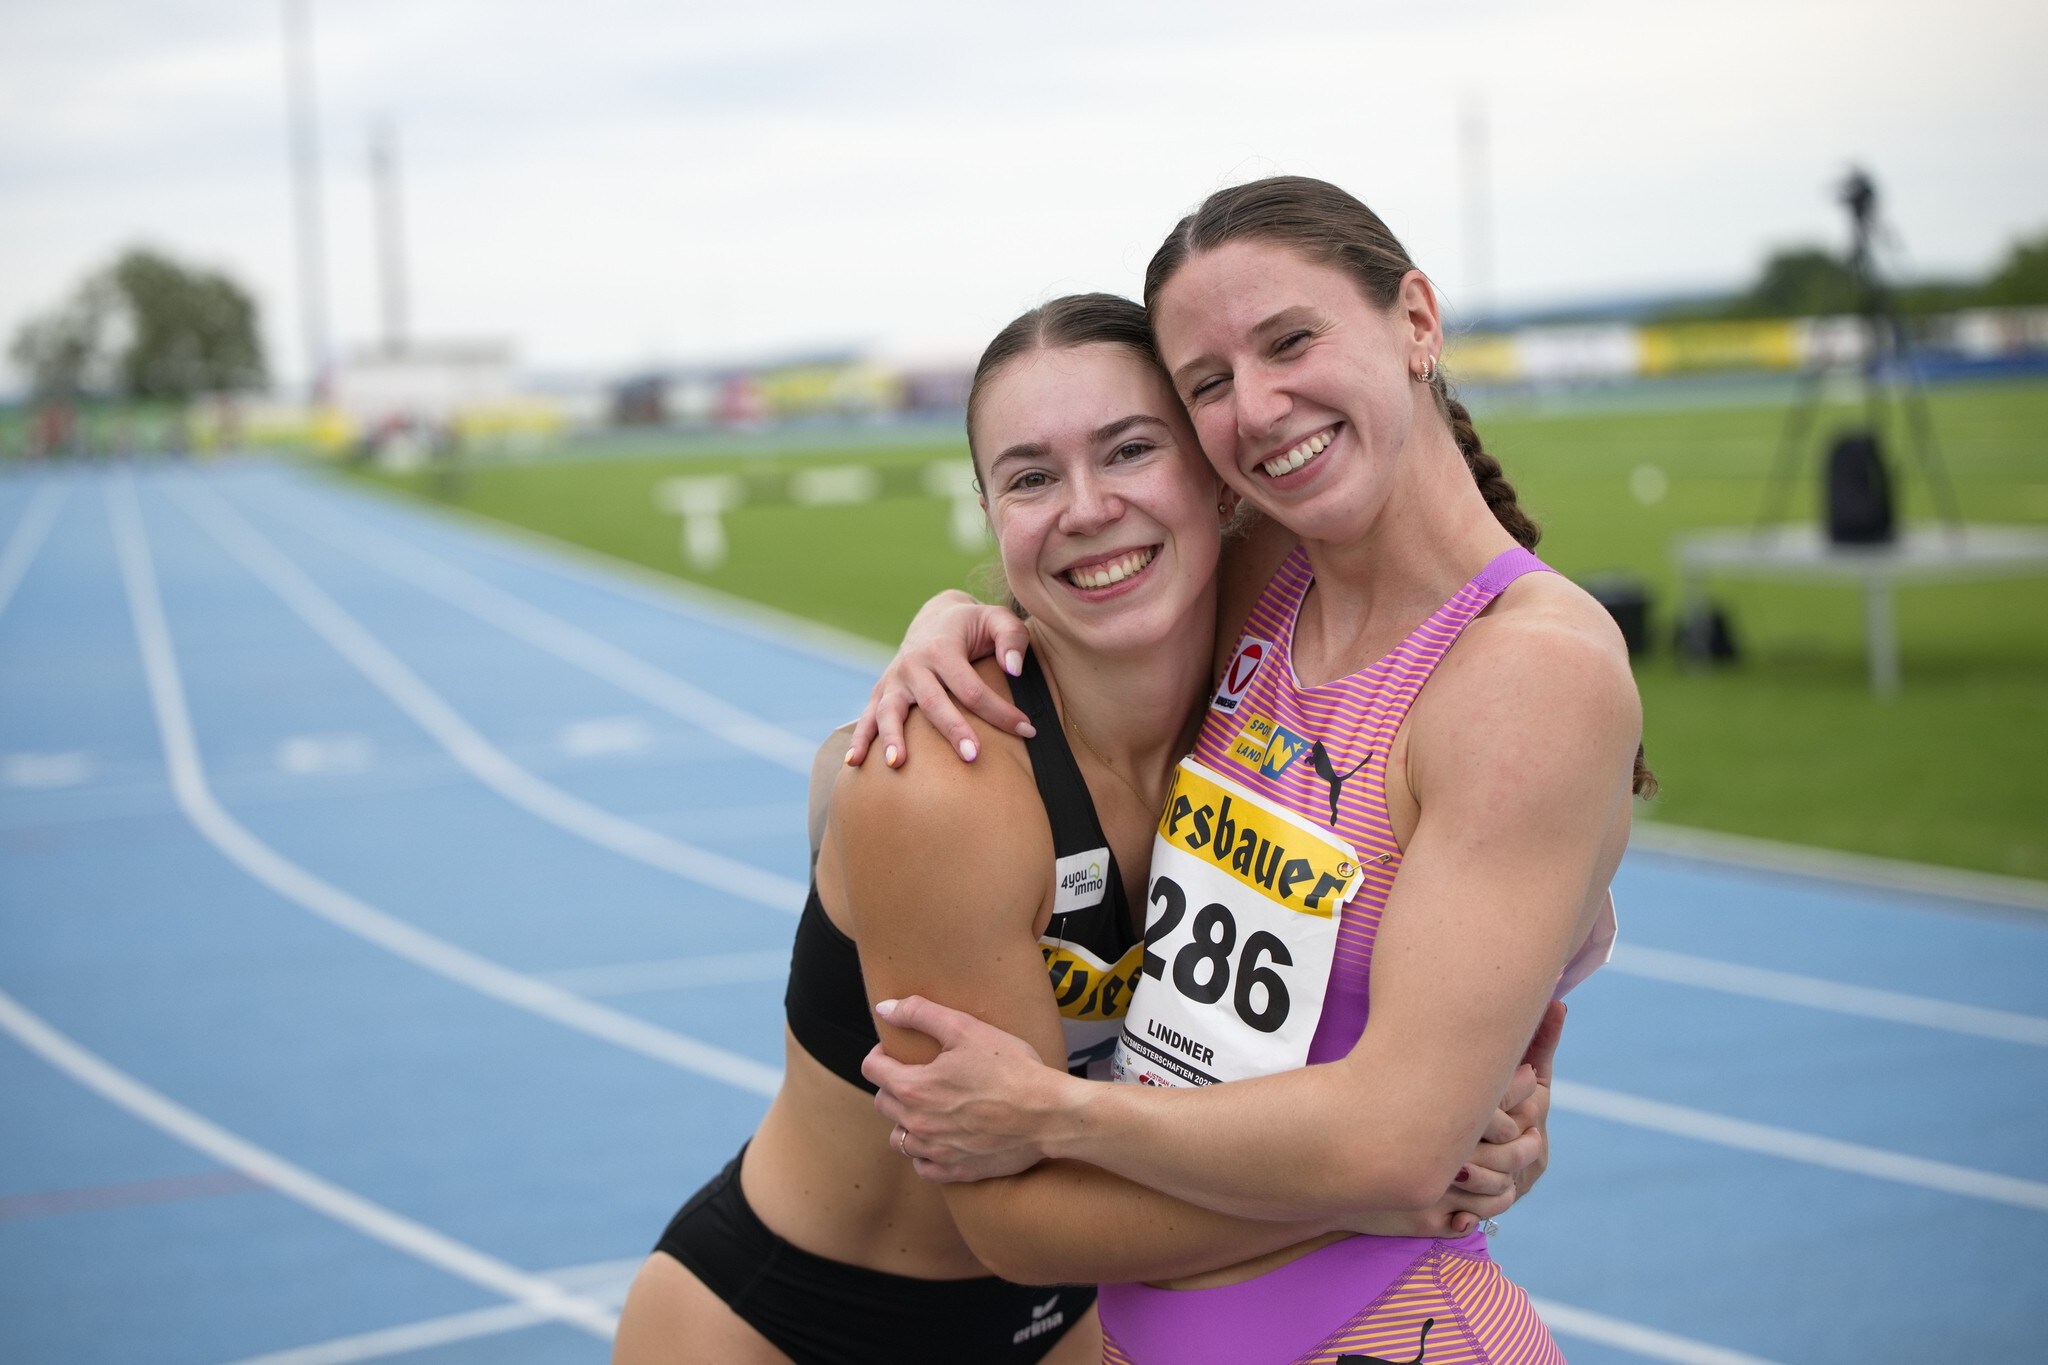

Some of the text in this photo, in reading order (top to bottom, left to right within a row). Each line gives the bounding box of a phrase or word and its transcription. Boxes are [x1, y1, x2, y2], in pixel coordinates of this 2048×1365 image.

[1236, 742, 1262, 763] LAND
[1061, 869, 1087, 889] 4you
[1074, 878, 1103, 896] immo
[1147, 1018, 1214, 1067] LINDNER
[1146, 1070, 1170, 1087] AUSTRIAN
